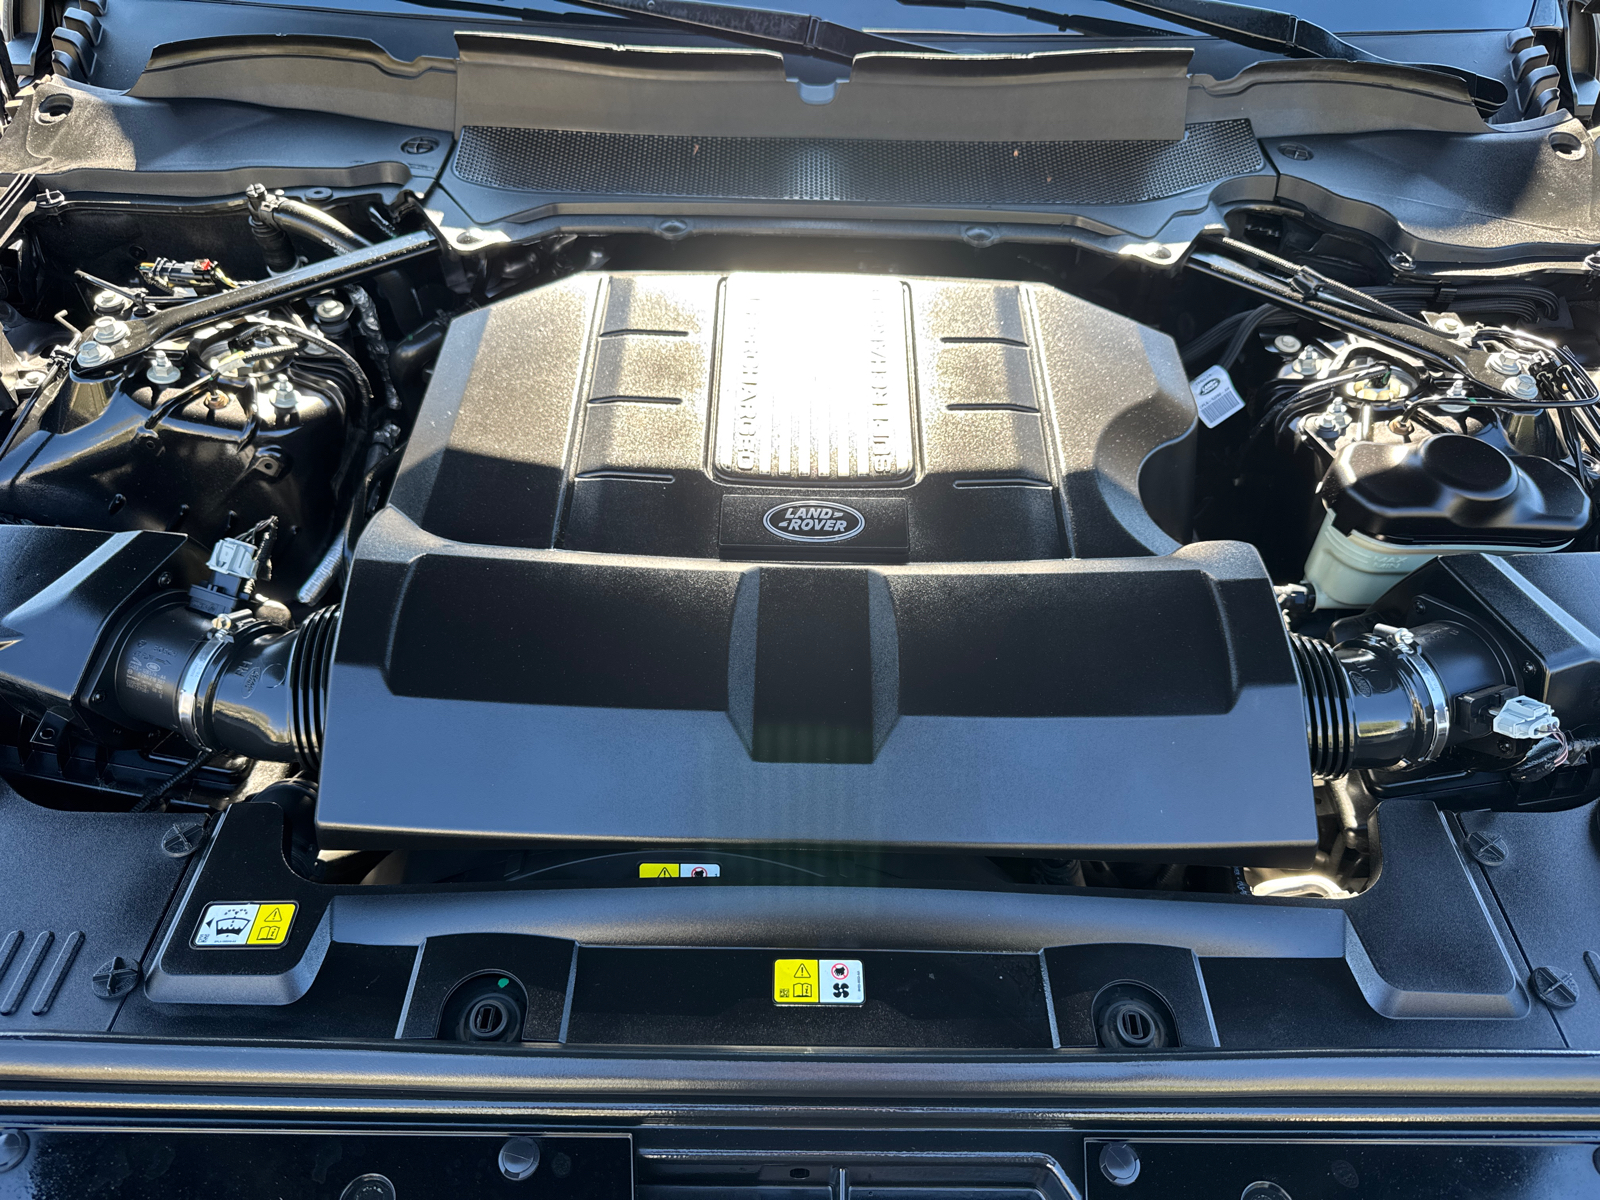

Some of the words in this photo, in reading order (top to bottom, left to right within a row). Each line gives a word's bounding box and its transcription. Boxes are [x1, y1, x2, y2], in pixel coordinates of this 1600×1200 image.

[737, 286, 760, 470] RCHARGED
[869, 284, 892, 473] SUPERCHAR
[785, 507, 833, 519] LAND
[788, 519, 847, 531] ROVER
[1373, 555, 1408, 563] MAX
